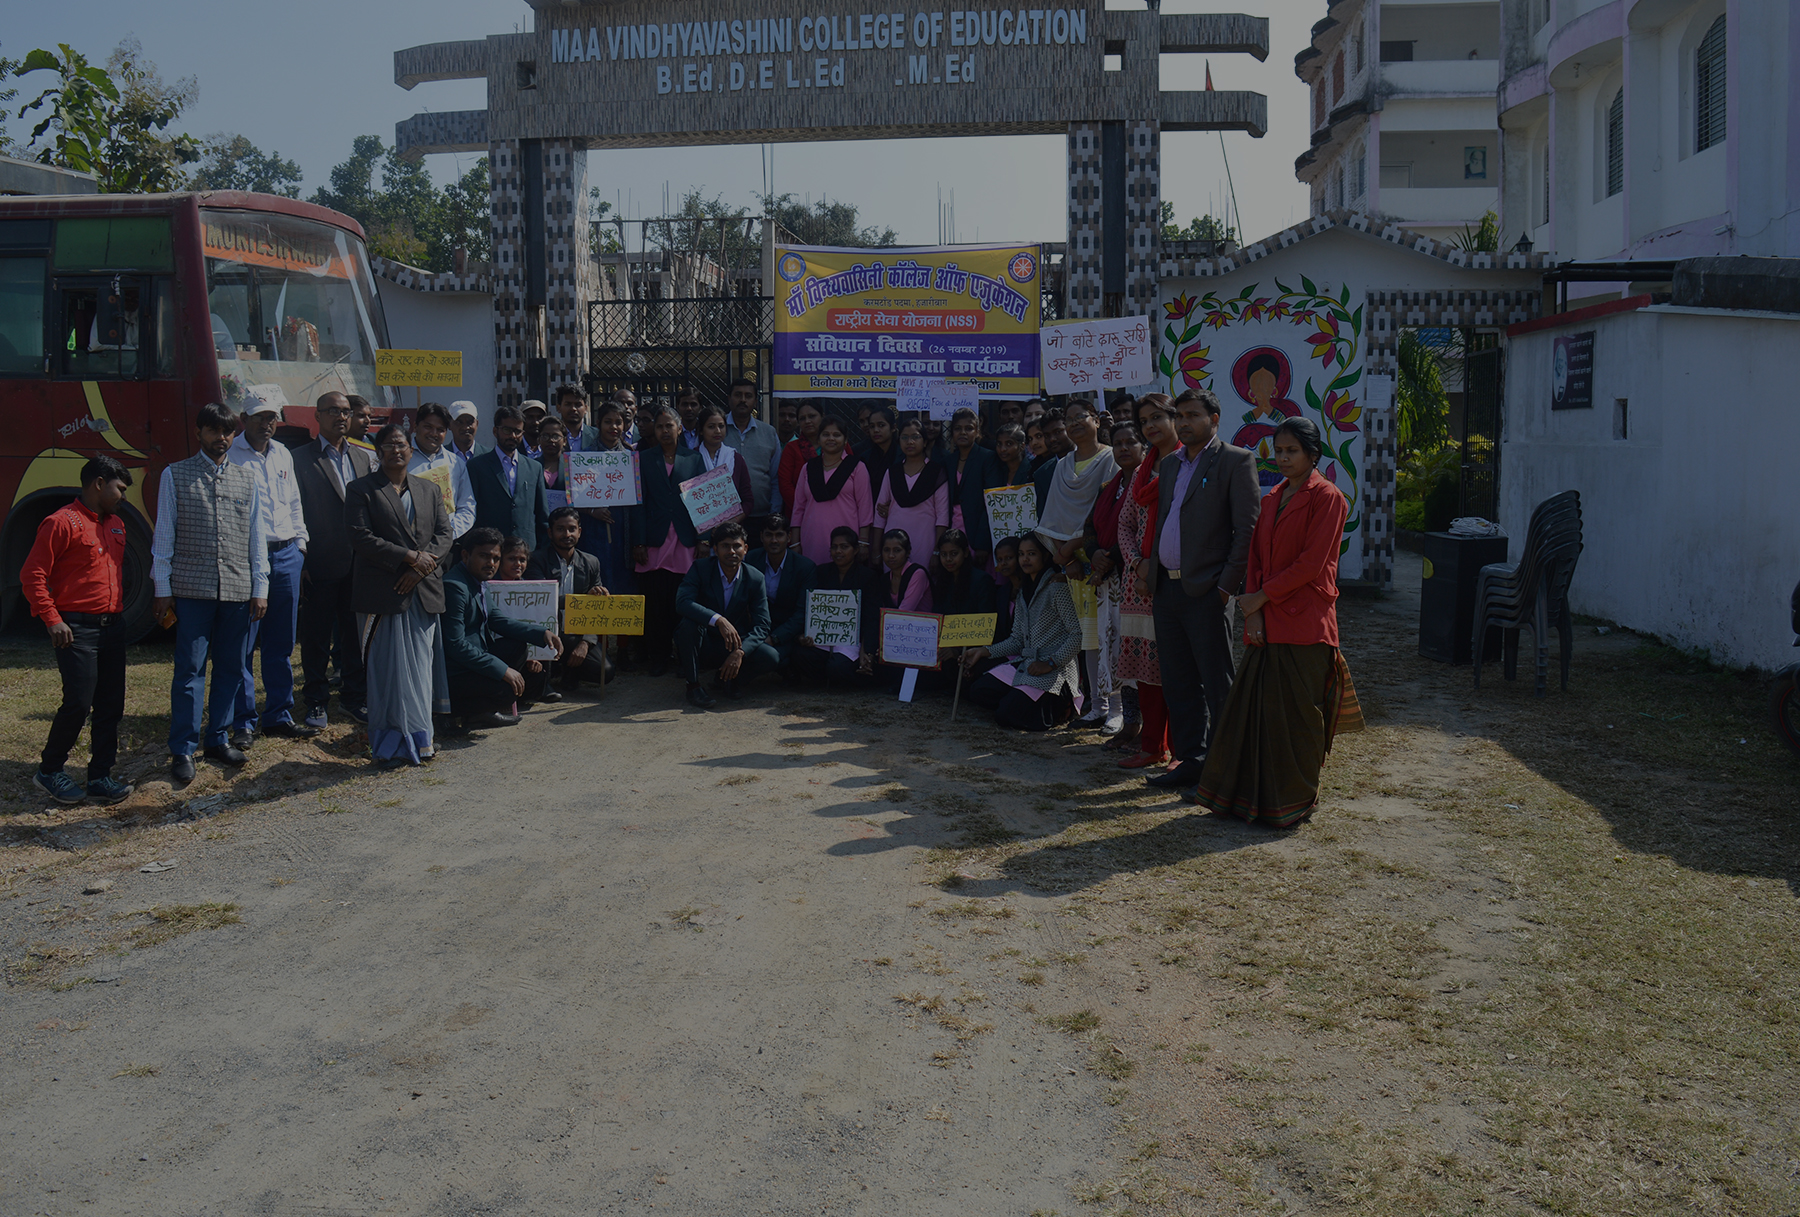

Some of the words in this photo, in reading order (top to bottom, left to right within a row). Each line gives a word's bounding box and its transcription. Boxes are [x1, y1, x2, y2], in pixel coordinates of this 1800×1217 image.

[552, 28, 600, 63] MAA
[607, 18, 792, 60] VINDHYAVASHINI
[799, 13, 905, 51] COLLEGE
[913, 12, 943, 48] OF
[951, 9, 1086, 46] EDUCATION
[887, 260, 933, 289] कॉलेज
[933, 262, 969, 295] ऑफ
[969, 274, 1030, 324] एजुकेशन
[916, 297, 947, 308] हजारीबाग
[835, 310, 871, 328] राष्ट्रीय
[874, 312, 899, 327] सेवा
[902, 312, 942, 327] योजना
[945, 315, 977, 329] (NSS)
[805, 334, 871, 352] संविधान
[877, 335, 923, 353] दिवस
[929, 344, 945, 355] (26
[948, 345, 977, 354] नवम्बर
[980, 345, 1007, 355] 2019)
[1047, 330, 1068, 348] जो
[792, 358, 854, 372] मतदाता
[951, 356, 1021, 374] कार्यक्रम
[1048, 353, 1082, 371] उसको
[810, 376, 844, 388] विनोबा
[846, 377, 868, 388] भावे
[1102, 367, 1123, 382] वोट
[942, 387, 968, 396] VOTE
[621, 452, 631, 466] दो
[586, 485, 602, 499] वोट
[842, 607, 857, 616] का
[814, 629, 839, 644] होता
